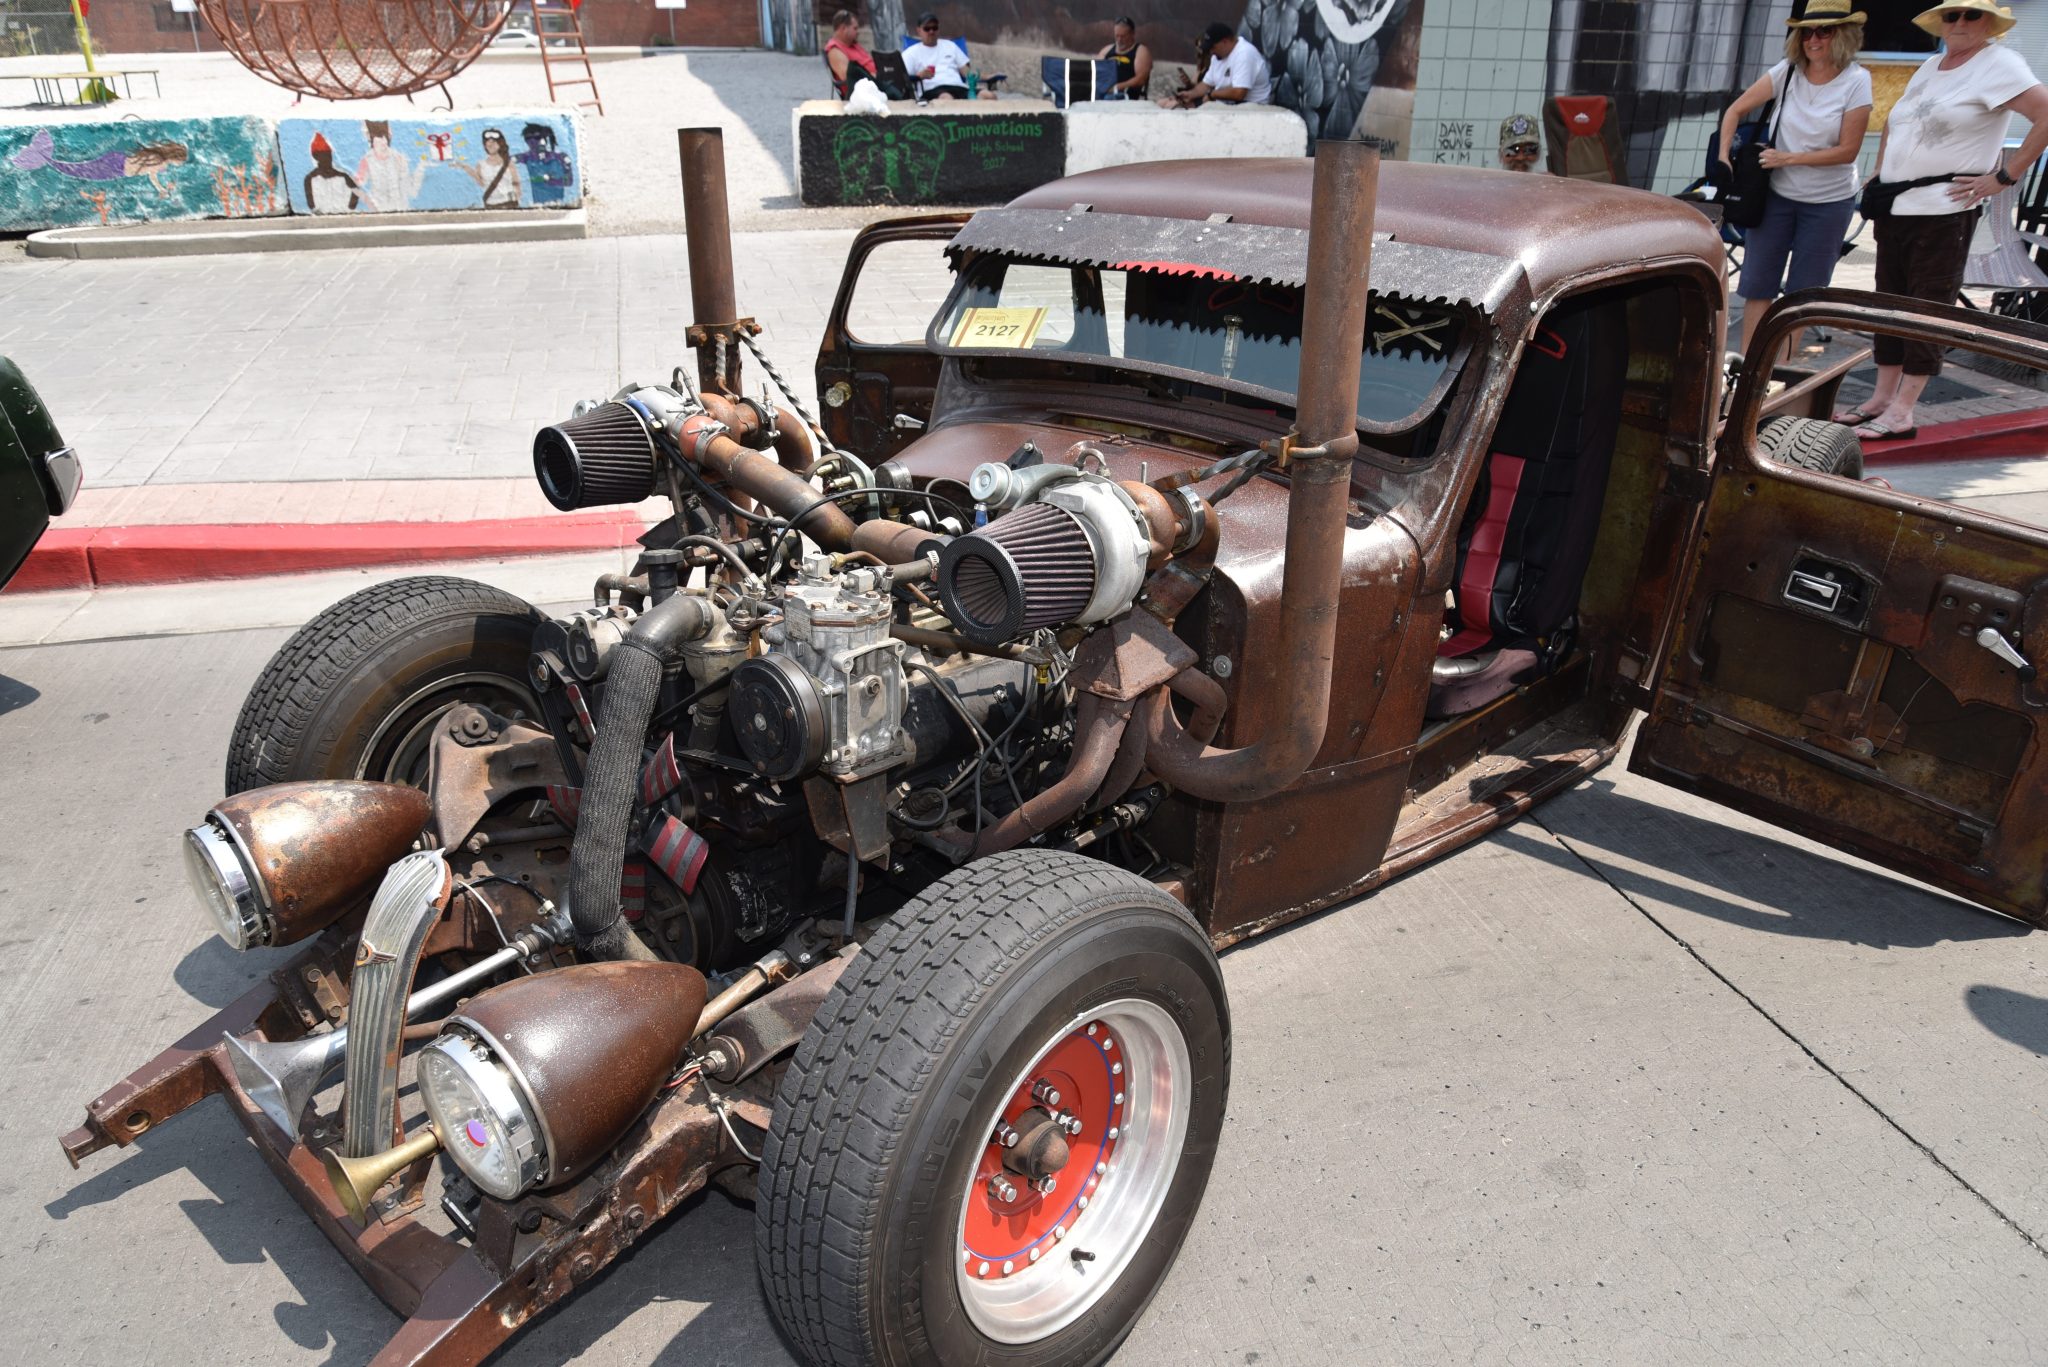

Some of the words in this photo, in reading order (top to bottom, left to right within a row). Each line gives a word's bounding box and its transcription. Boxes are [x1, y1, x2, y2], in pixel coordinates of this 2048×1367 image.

[944, 120, 1043, 144] Innovations
[1440, 122, 1475, 137] DAVE
[970, 142, 993, 157] High
[994, 140, 1024, 153] School
[1438, 138, 1474, 150] YOUNG
[983, 156, 1007, 170] 2017
[975, 324, 1020, 336] 2127
